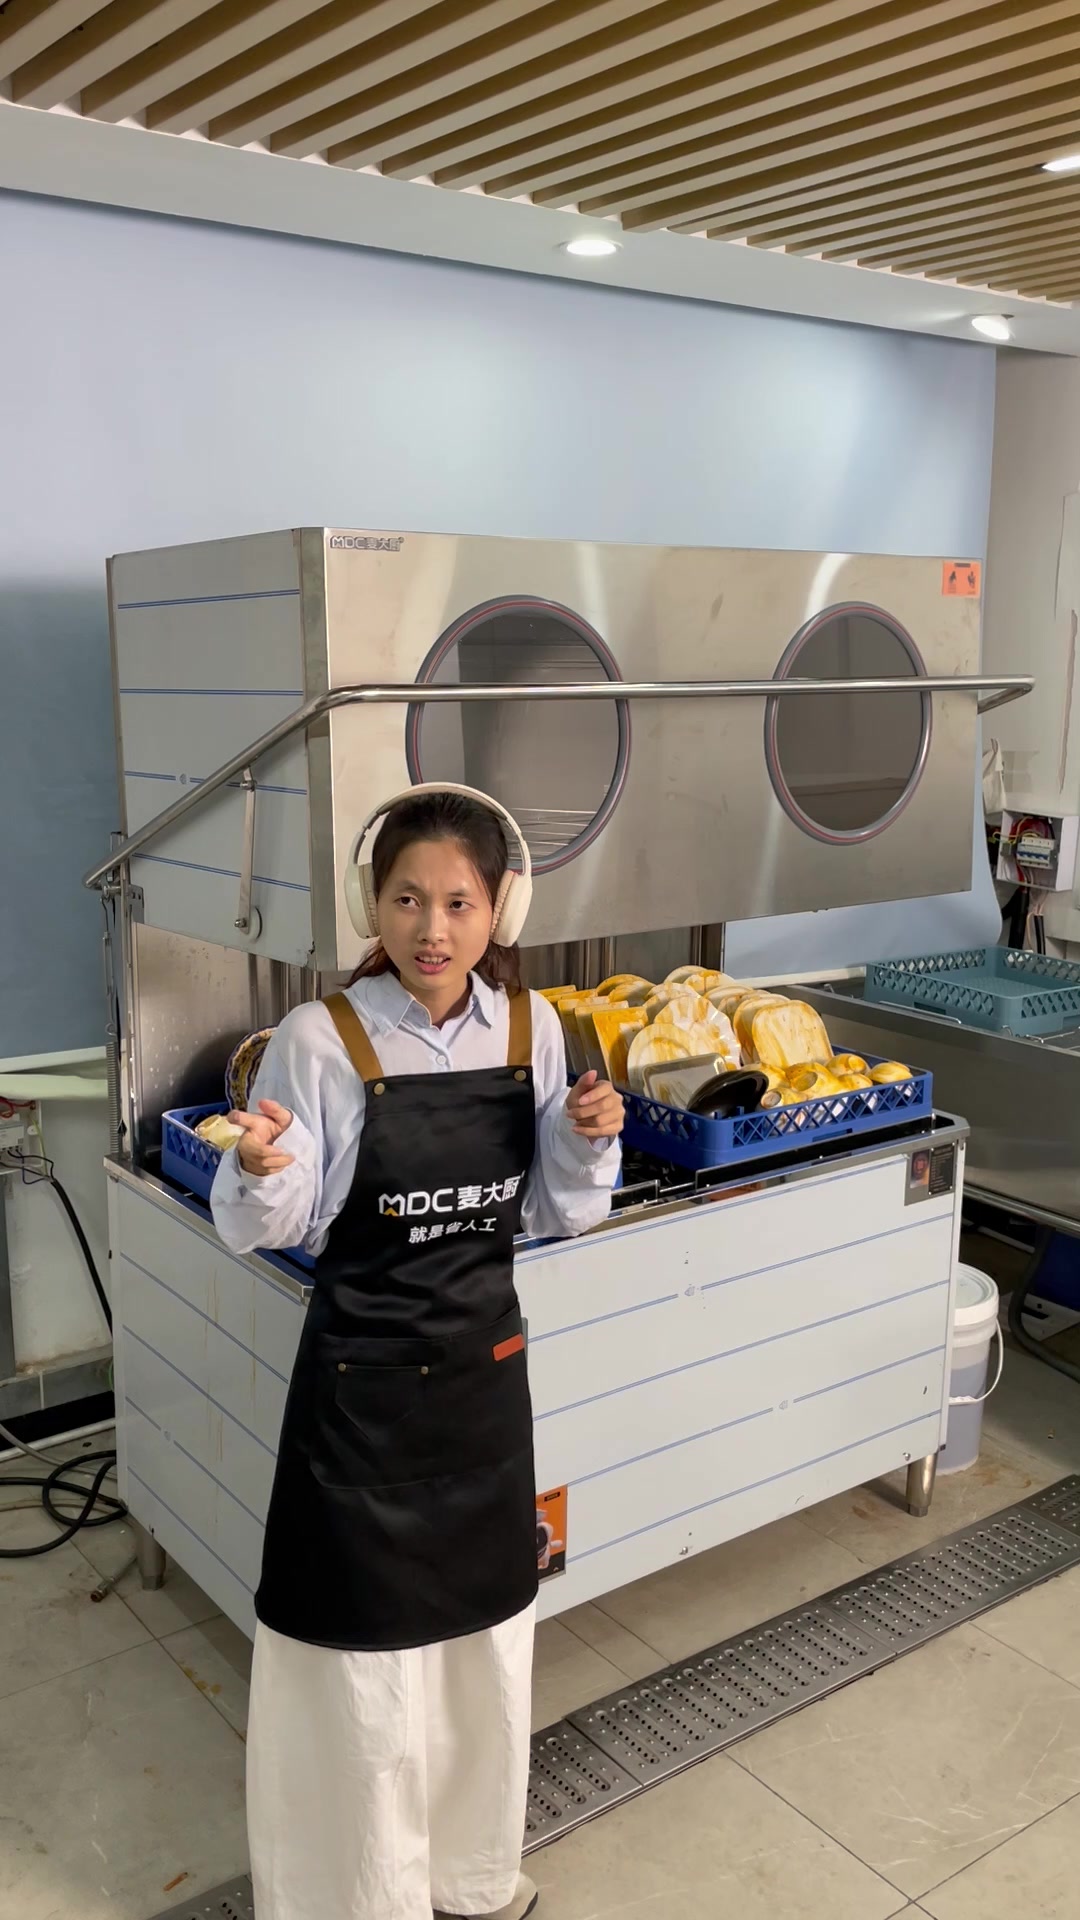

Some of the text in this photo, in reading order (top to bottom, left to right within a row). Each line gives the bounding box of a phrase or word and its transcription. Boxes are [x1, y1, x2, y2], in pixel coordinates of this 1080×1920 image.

[408, 1217, 497, 1244] 就是省人工
